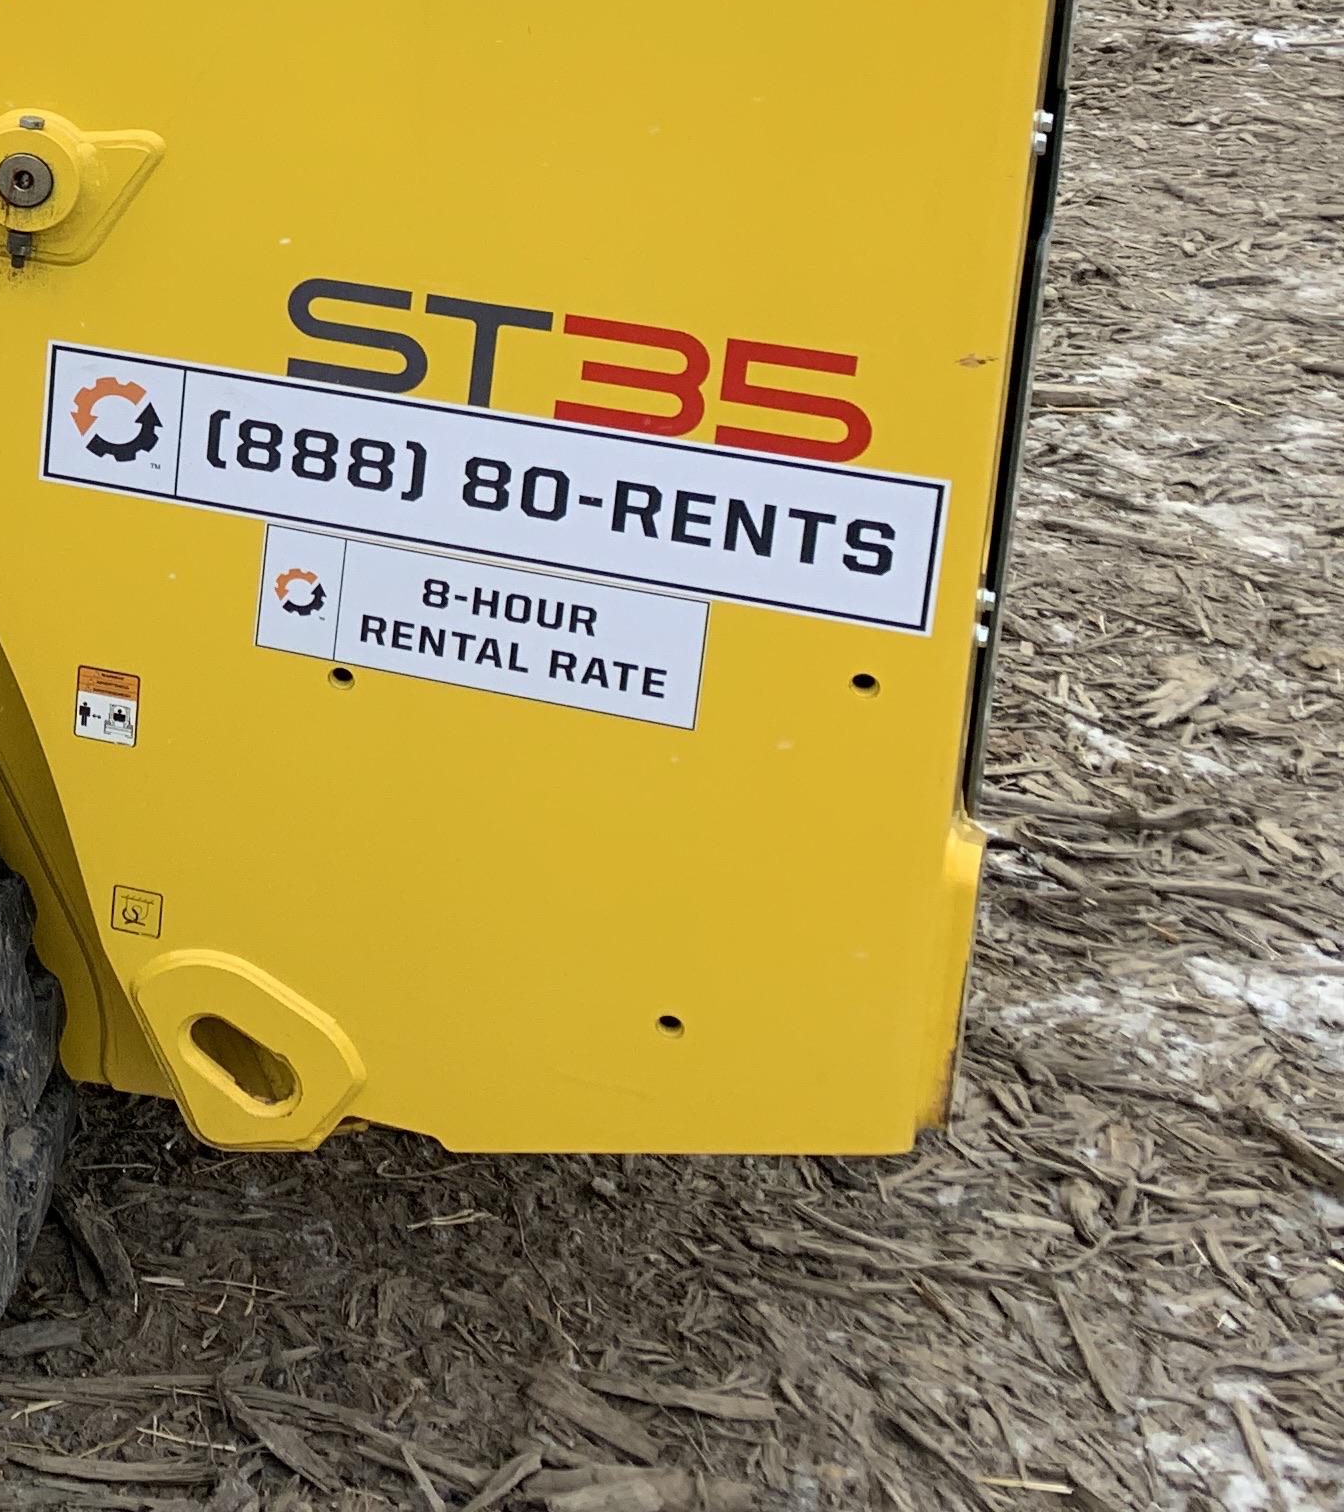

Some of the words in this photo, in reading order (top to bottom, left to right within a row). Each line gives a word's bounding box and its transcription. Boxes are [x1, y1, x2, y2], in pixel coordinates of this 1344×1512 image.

[286, 277, 873, 464] ST35
[206, 409, 427, 502] (888)
[462, 456, 896, 576] 80-RENTS
[359, 614, 530, 674] RENTAL
[548, 649, 668, 699] RATE
[422, 578, 598, 637] 8-HOUR
